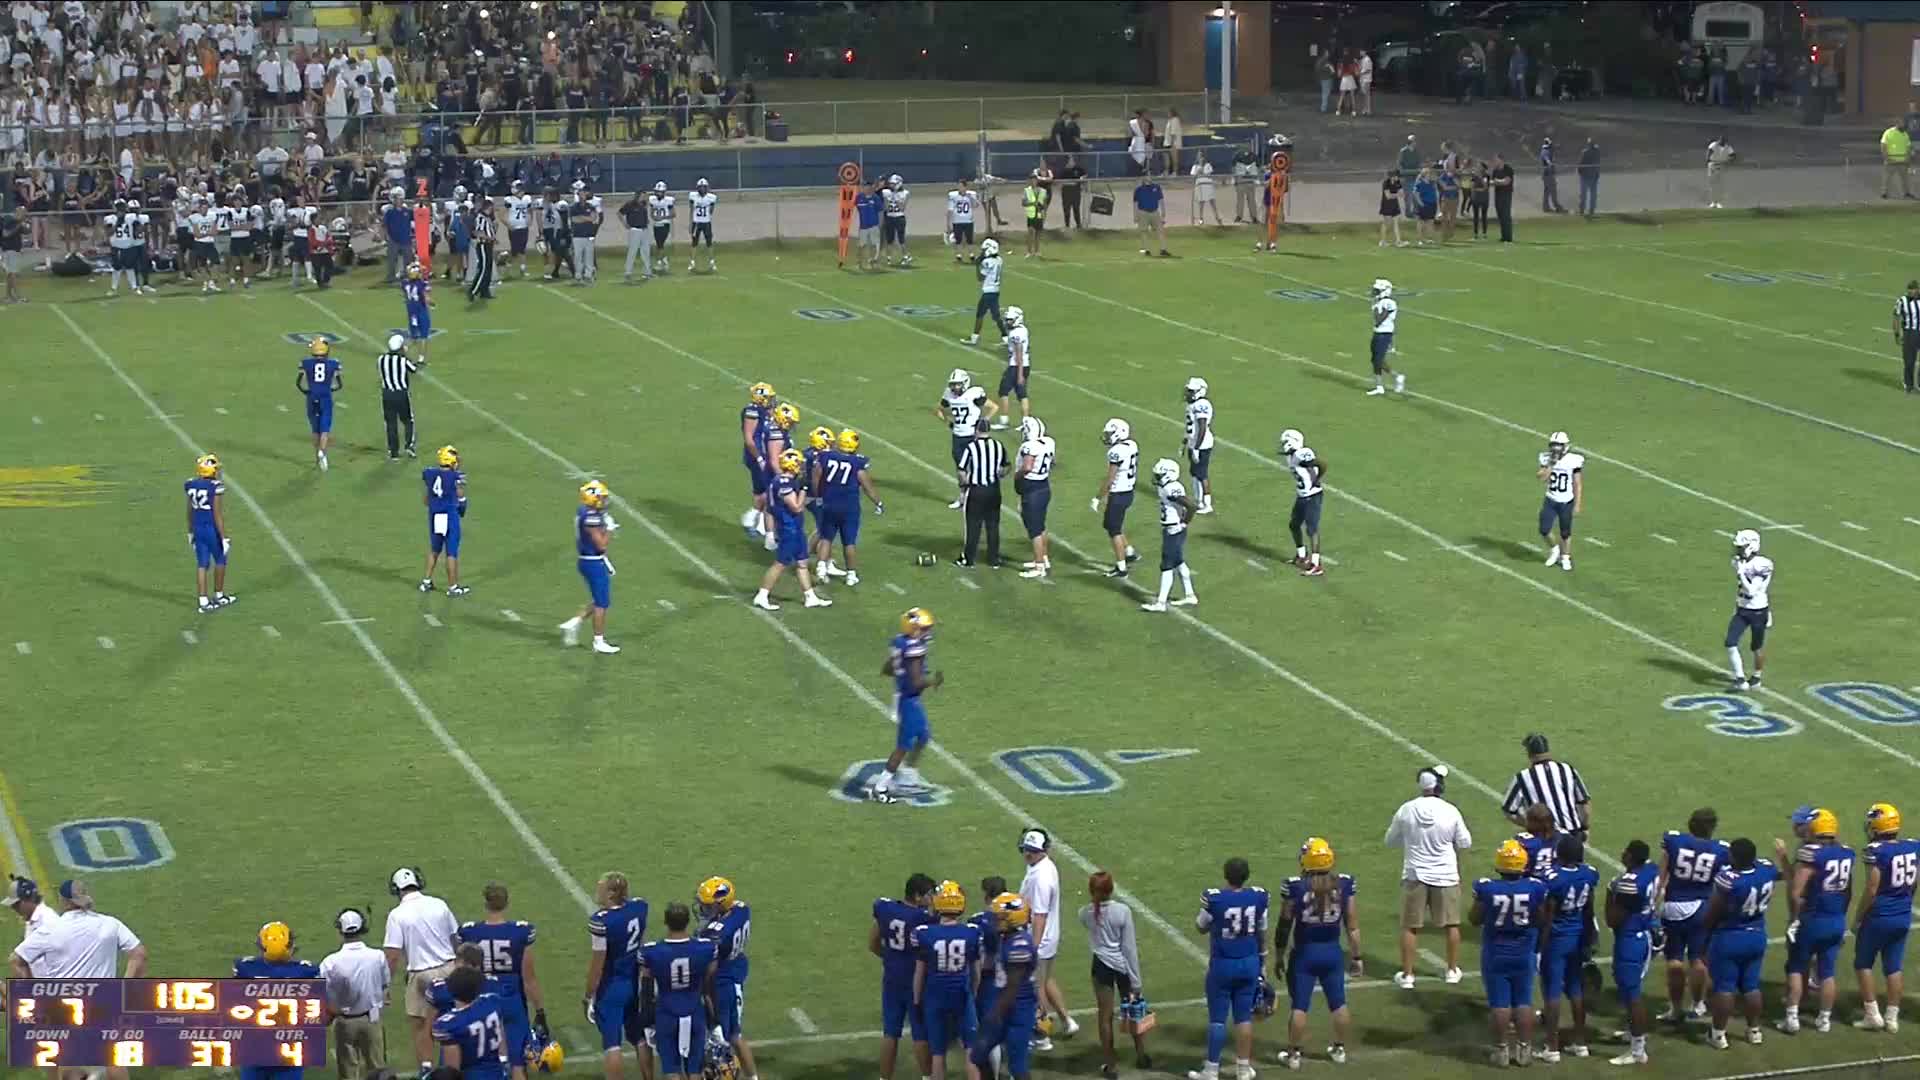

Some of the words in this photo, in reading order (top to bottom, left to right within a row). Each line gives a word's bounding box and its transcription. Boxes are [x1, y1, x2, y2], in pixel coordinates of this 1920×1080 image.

[313, 362, 326, 382] 8
[432, 475, 444, 498] 4
[827, 459, 852, 485] 77
[1549, 471, 1569, 493] 20
[1890, 852, 1918, 888] 65
[1492, 893, 1531, 927] 75
[1742, 880, 1775, 917] 42
[625, 919, 640, 952] 2
[889, 918, 906, 951] 3
[1222, 905, 1257, 940] 31
[479, 939, 513, 973] 15
[933, 939, 967, 972] 18
[669, 957, 690, 989] 0
